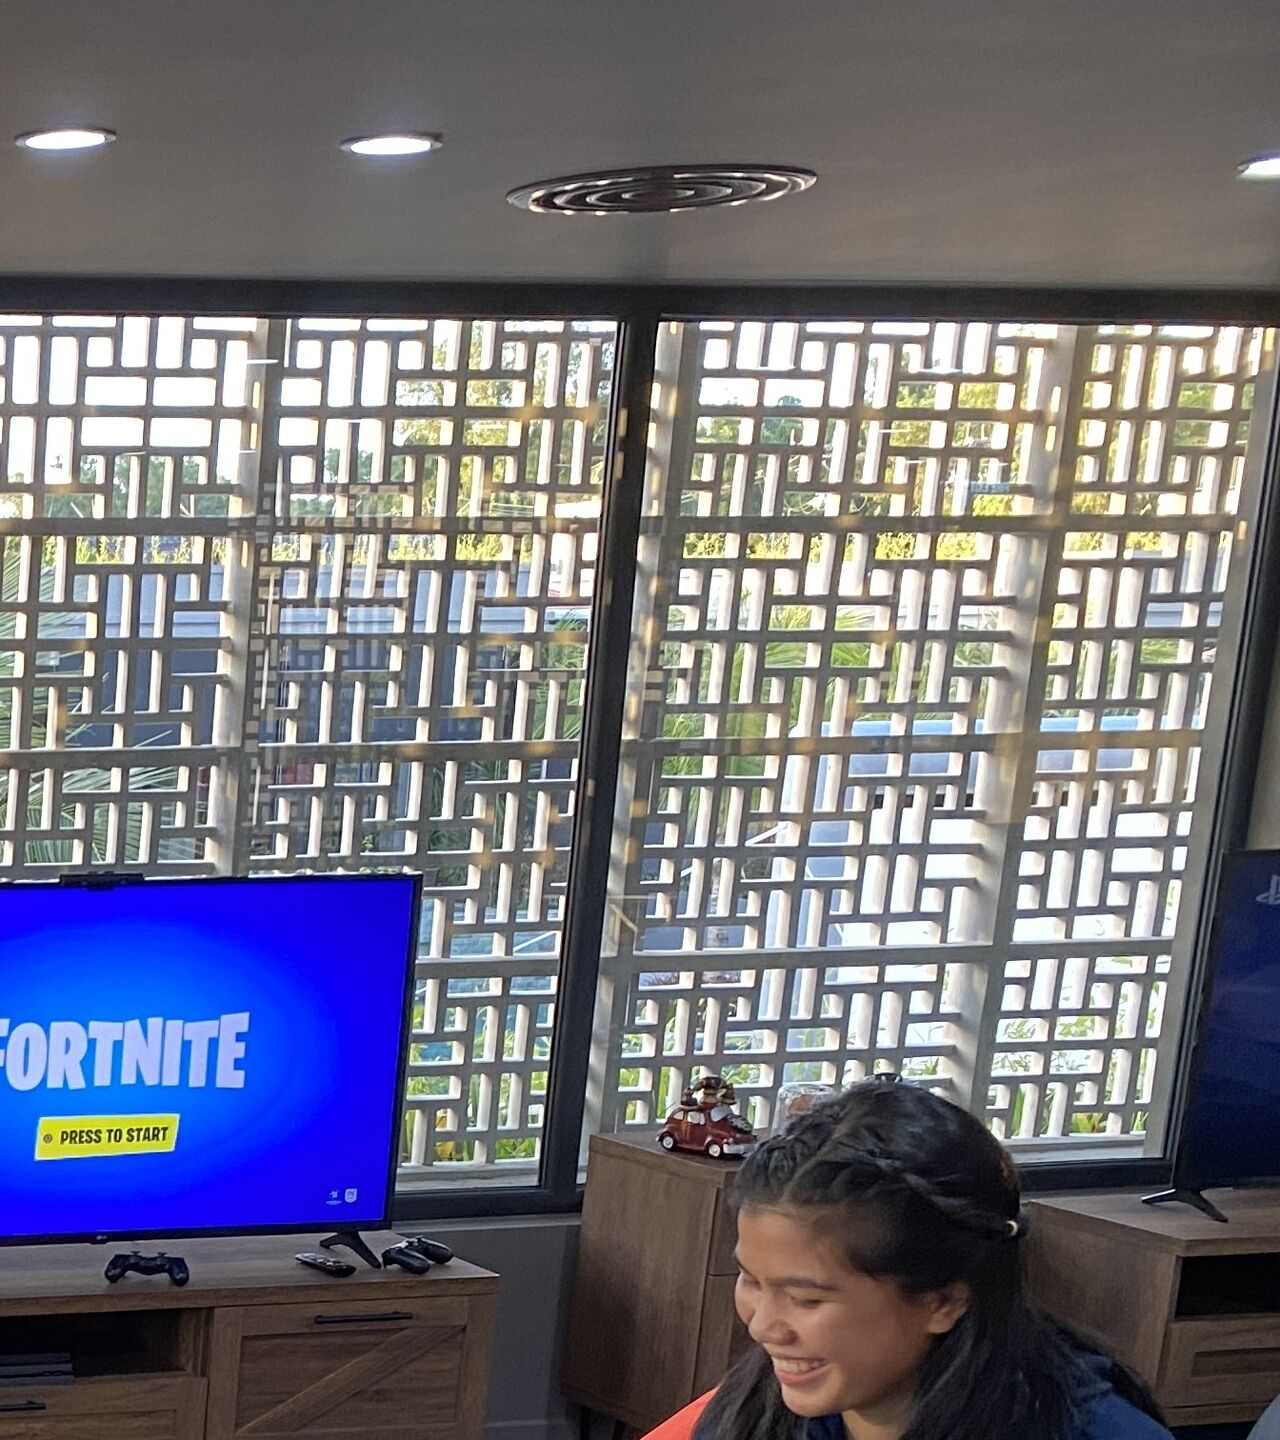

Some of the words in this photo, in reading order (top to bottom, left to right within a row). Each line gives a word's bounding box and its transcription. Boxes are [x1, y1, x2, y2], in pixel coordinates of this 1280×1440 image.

[60, 1129, 102, 1145] PRESS
[106, 1128, 123, 1143] TO
[126, 1126, 169, 1143] START
